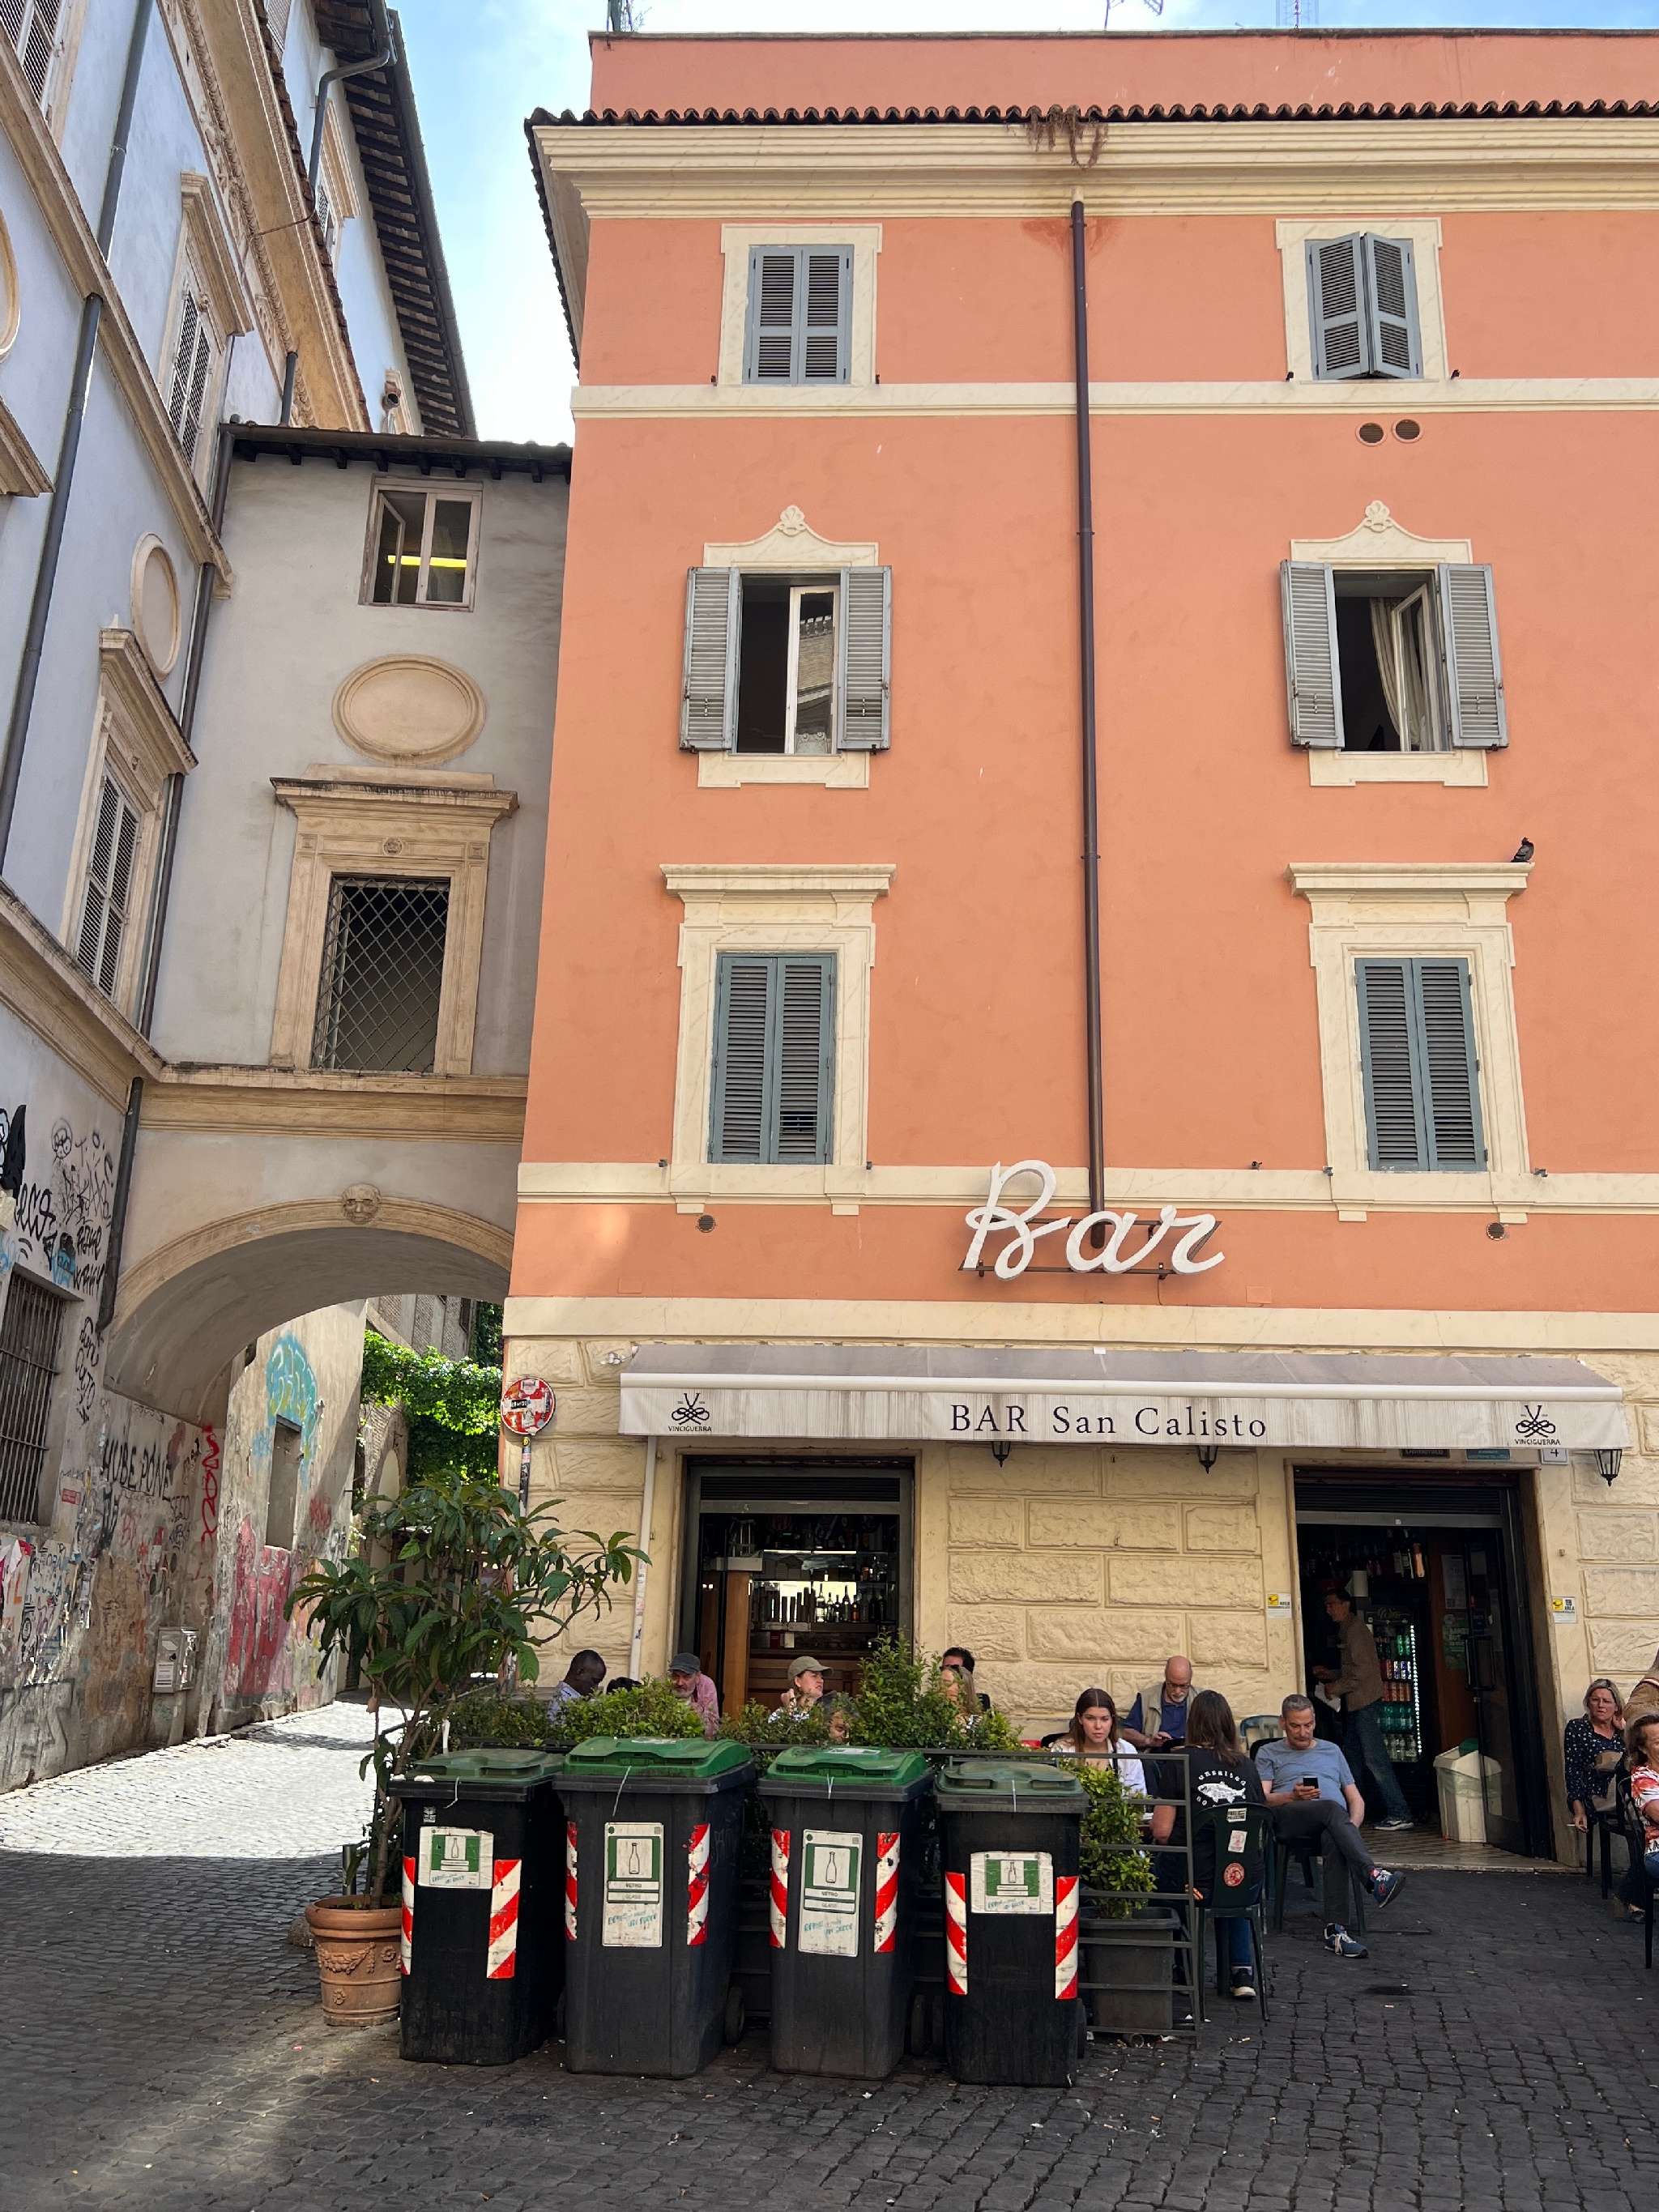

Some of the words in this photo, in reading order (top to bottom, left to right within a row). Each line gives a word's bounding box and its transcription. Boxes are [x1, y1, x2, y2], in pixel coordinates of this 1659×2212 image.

[965, 1159, 1226, 1281] Bar
[950, 1404, 1030, 1433] BAR
[1052, 1405, 1116, 1434] San
[1134, 1406, 1267, 1438] Calisto
